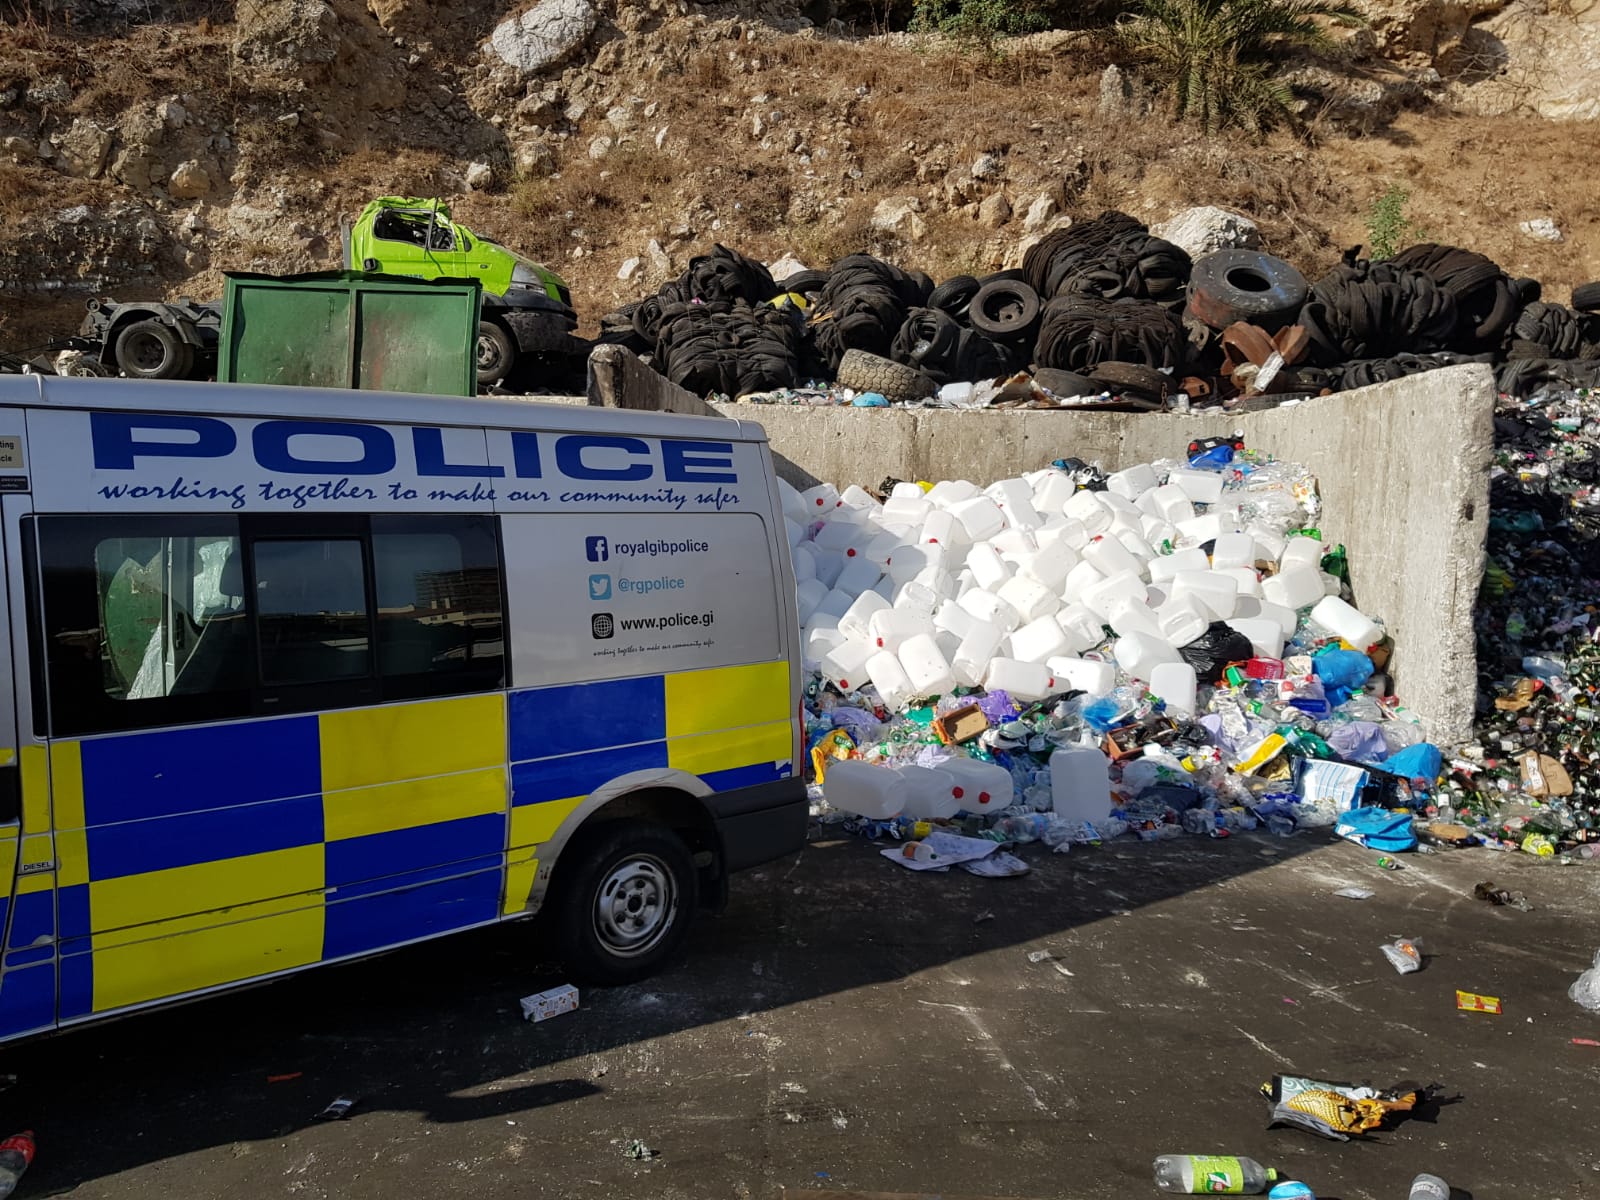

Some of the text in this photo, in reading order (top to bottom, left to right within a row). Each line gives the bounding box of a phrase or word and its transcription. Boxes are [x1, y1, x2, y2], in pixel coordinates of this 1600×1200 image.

[90, 411, 738, 484] POLICE
[97, 477, 740, 511] working together to make our community safer
[614, 539, 709, 557] royalgibpolice
[618, 576, 685, 594] @rgpolice
[620, 610, 714, 631] www.police.gi
[23, 862, 50, 870] DIESEL
